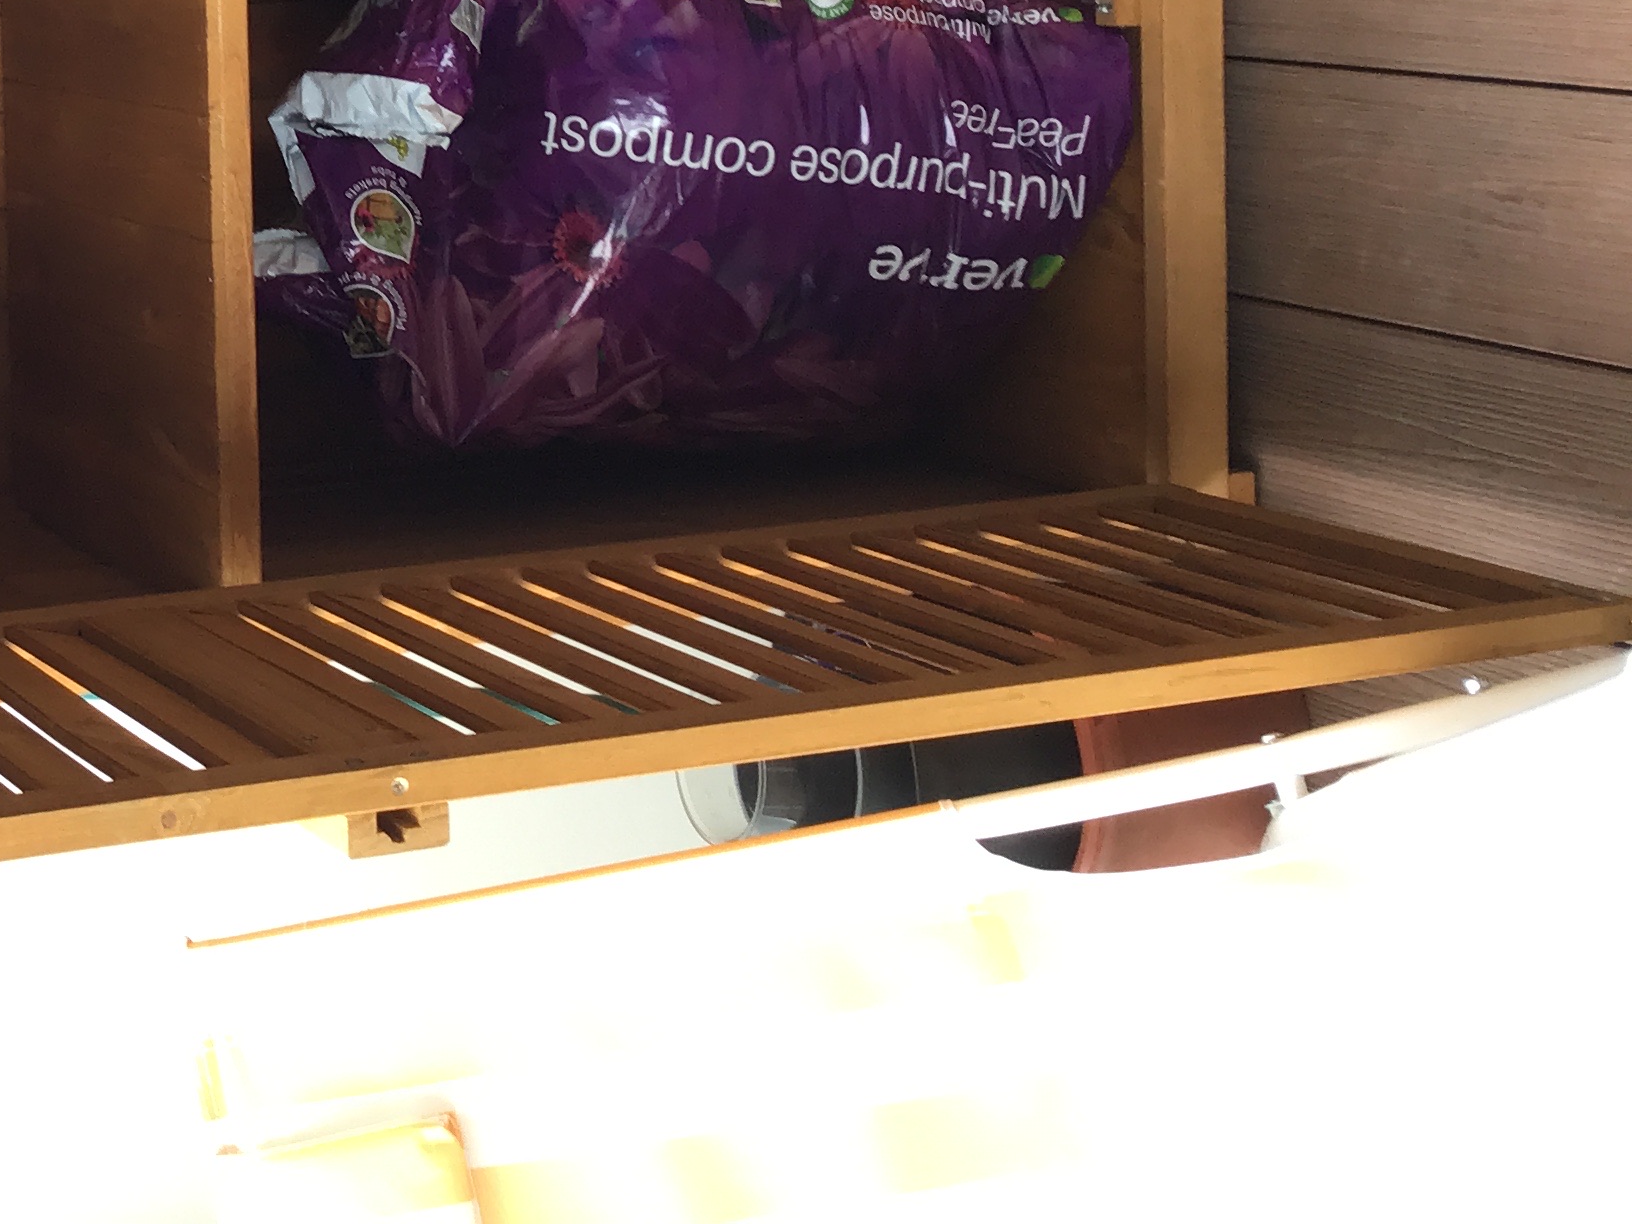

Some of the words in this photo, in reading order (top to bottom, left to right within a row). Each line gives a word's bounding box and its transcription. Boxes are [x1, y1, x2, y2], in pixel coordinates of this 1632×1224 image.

[987, 5, 1061, 26] verve
[538, 109, 775, 177] compost
[790, 141, 1086, 221] Multi-purpose
[868, 244, 1029, 291] verve
